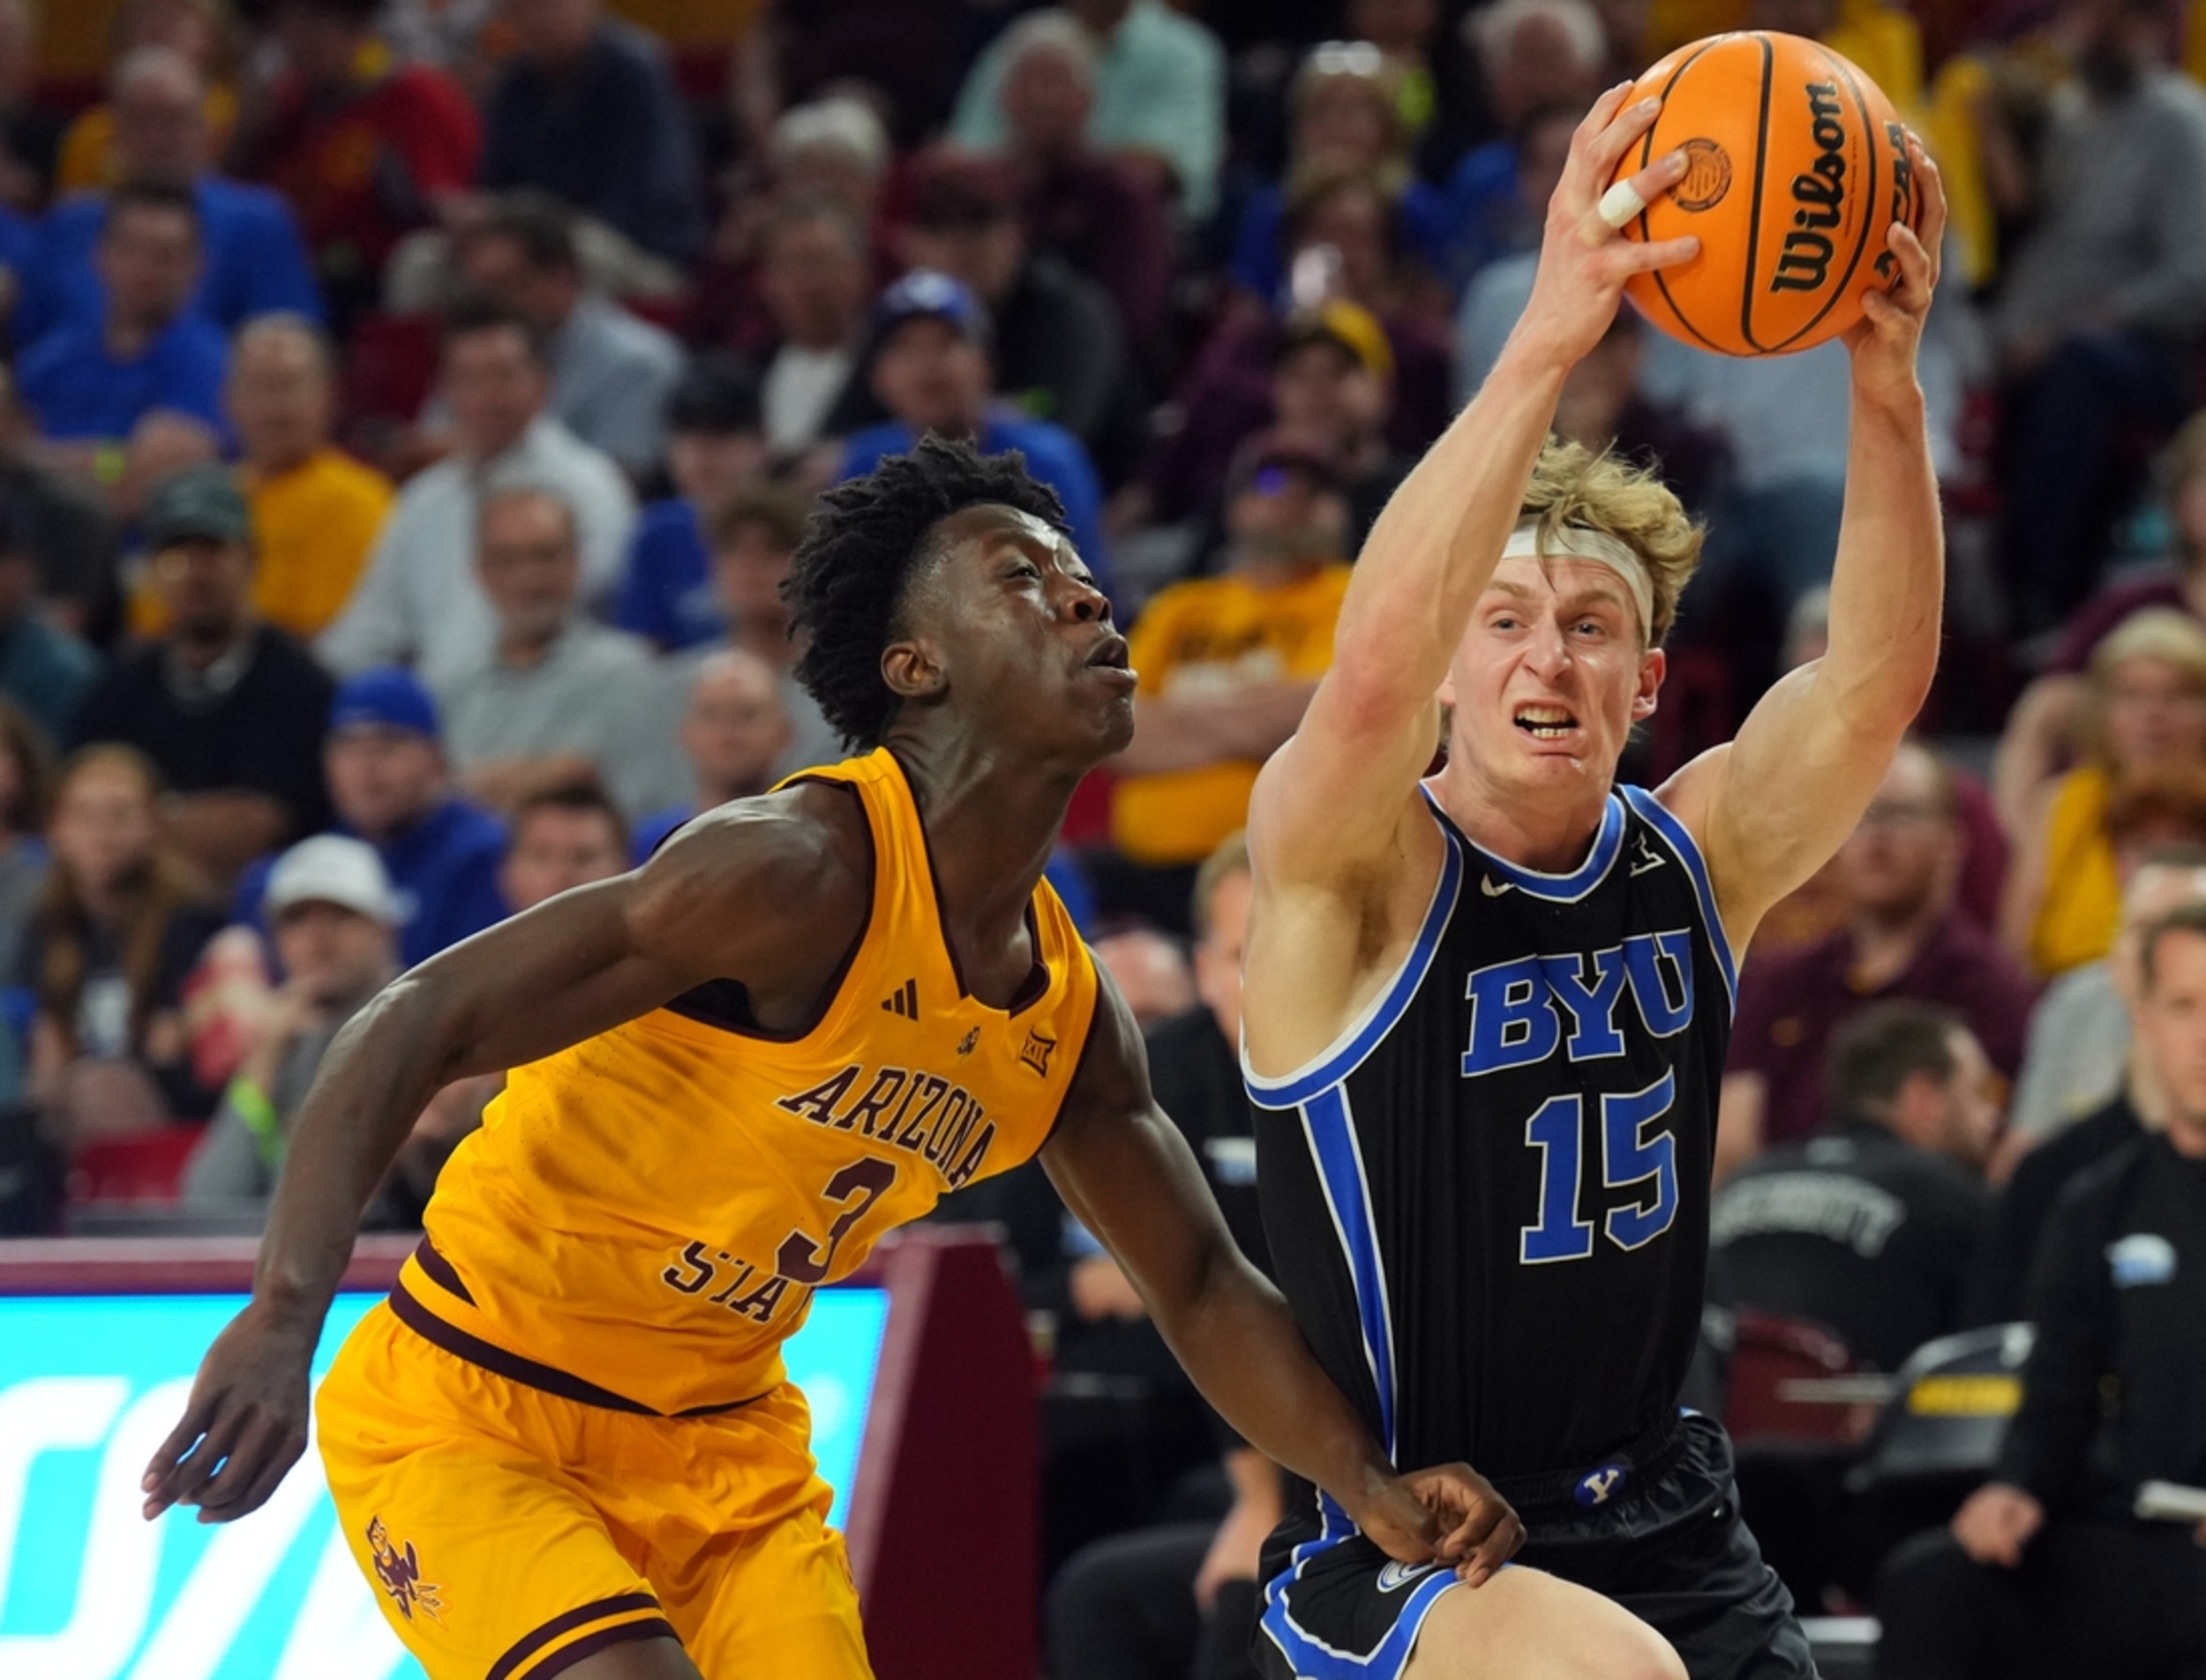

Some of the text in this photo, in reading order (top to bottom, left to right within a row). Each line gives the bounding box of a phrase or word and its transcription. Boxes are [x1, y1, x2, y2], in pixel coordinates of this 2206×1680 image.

[1769, 79, 1847, 295] Wilson
[1460, 926, 1692, 1078] BYU
[773, 1064, 997, 1191] ARIZONA
[1519, 1064, 1678, 1264] 15
[776, 1154, 897, 1286] 3
